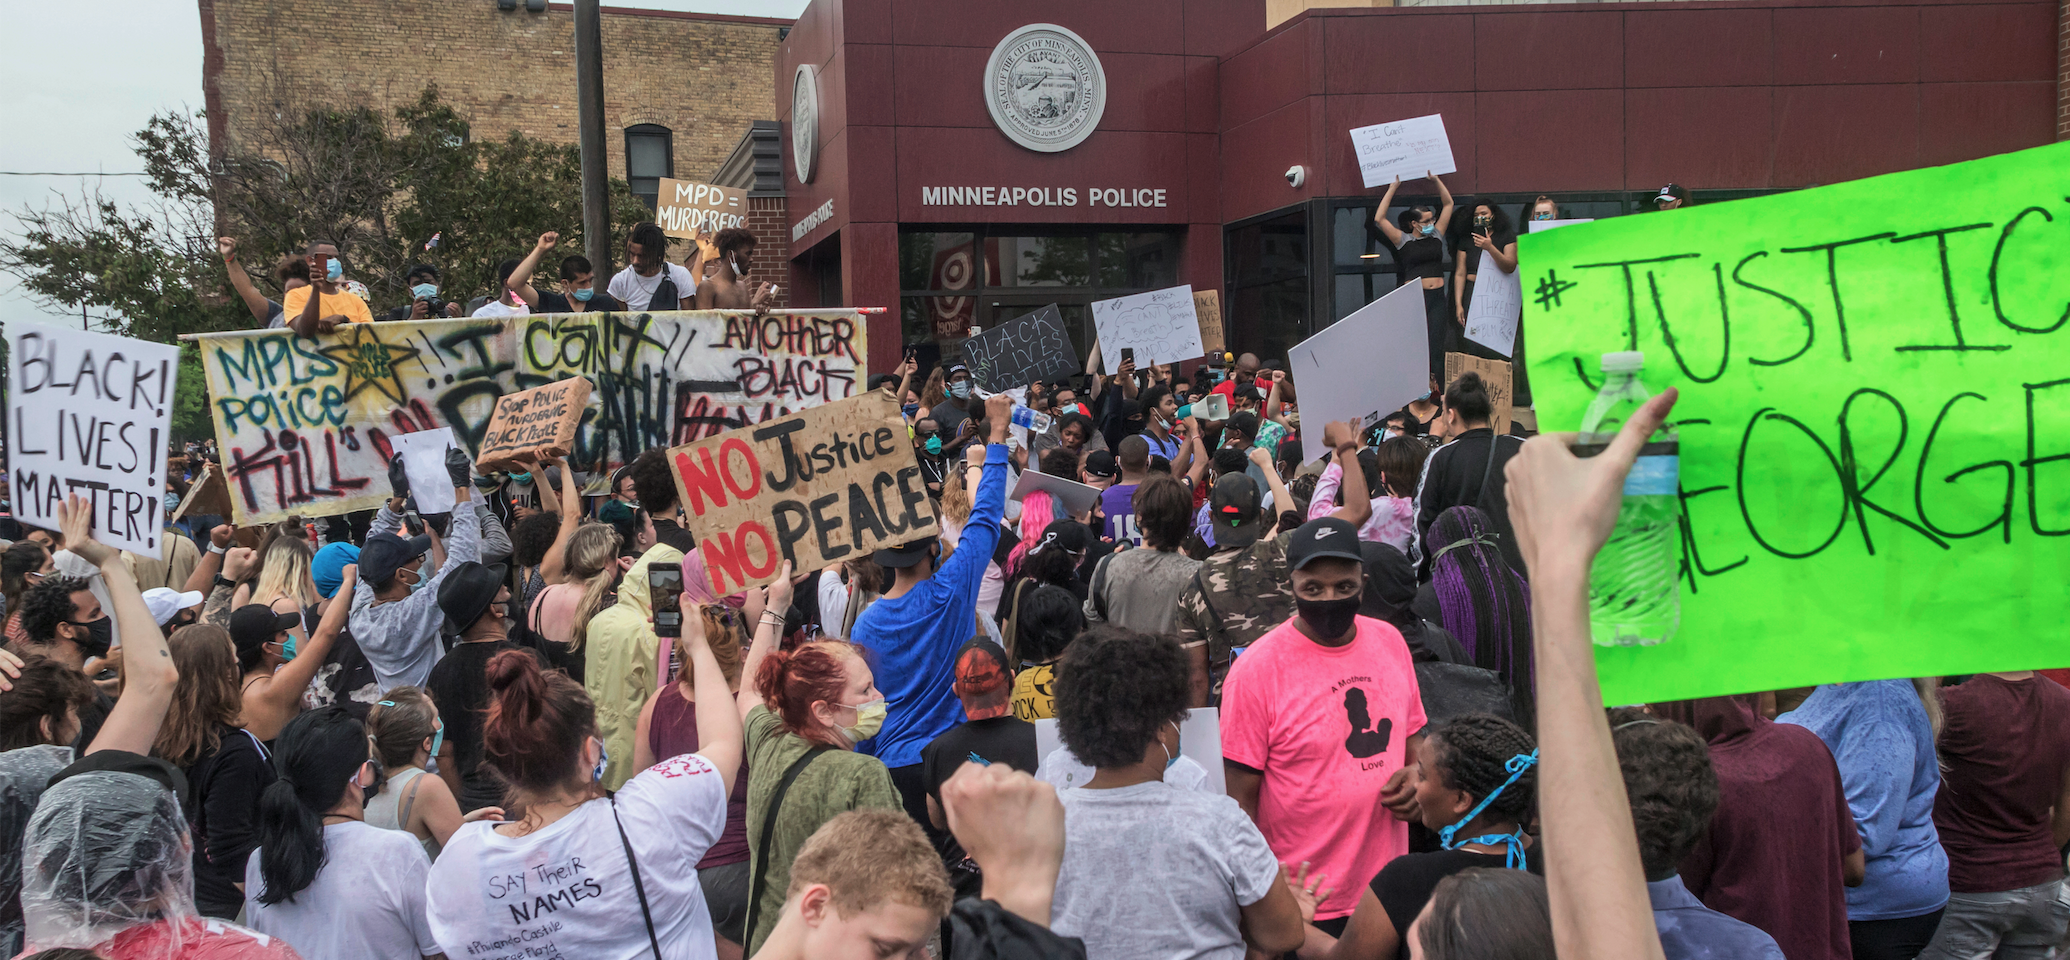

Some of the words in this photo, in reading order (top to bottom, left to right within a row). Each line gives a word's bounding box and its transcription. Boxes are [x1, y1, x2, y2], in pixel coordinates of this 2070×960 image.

[1002, 55, 1016, 75] THE
[1014, 42, 1032, 57] CITY
[1032, 39, 1044, 48] OF
[1010, 114, 1041, 136] APPROVED
[675, 182, 725, 206] MPD
[922, 186, 1078, 207] MINNEAPOLIS
[1088, 187, 1167, 208] POLICE
[1477, 294, 1515, 318] THREAT
[964, 310, 1061, 372] BLACK
[994, 331, 1064, 380] LIVES
[17, 331, 169, 418] BLACK!
[216, 333, 340, 393] MPLS
[732, 356, 857, 404] BLACK
[497, 397, 530, 420] STOP
[532, 386, 570, 409] POLICE
[15, 406, 159, 487] LIVES!
[483, 427, 529, 450] BLACK
[675, 437, 762, 517] NO
[752, 418, 896, 493] Justice
[702, 520, 778, 596] NO
[771, 466, 935, 572] PEACE
[1331, 686, 1339, 694] A
[1338, 675, 1372, 689] Mothers
[1361, 759, 1385, 772] Love
[488, 871, 527, 900] SAY
[508, 877, 602, 925] NAMES
